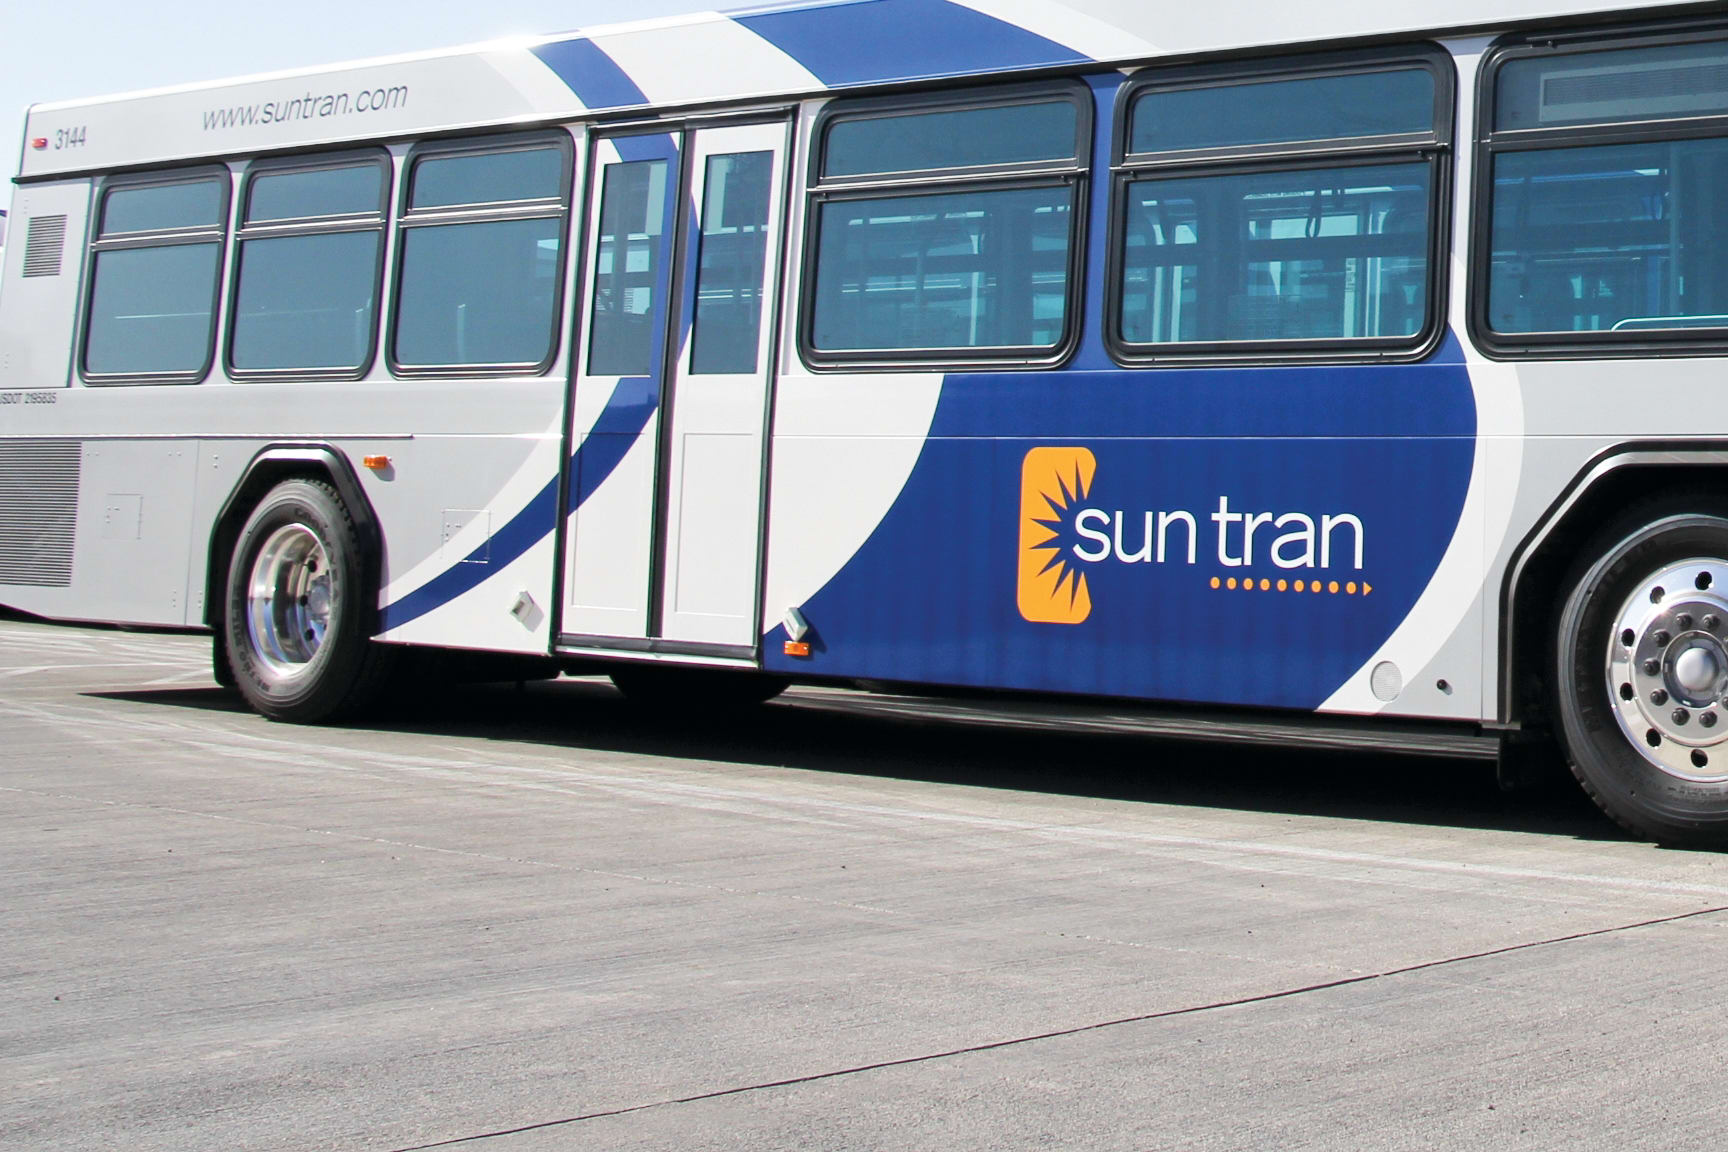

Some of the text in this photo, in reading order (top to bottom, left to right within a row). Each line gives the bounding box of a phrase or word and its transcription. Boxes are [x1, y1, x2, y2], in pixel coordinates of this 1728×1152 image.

[203, 85, 408, 130] www.suntran.com
[55, 126, 87, 149] 3144
[1072, 495, 1364, 570] sun tran
